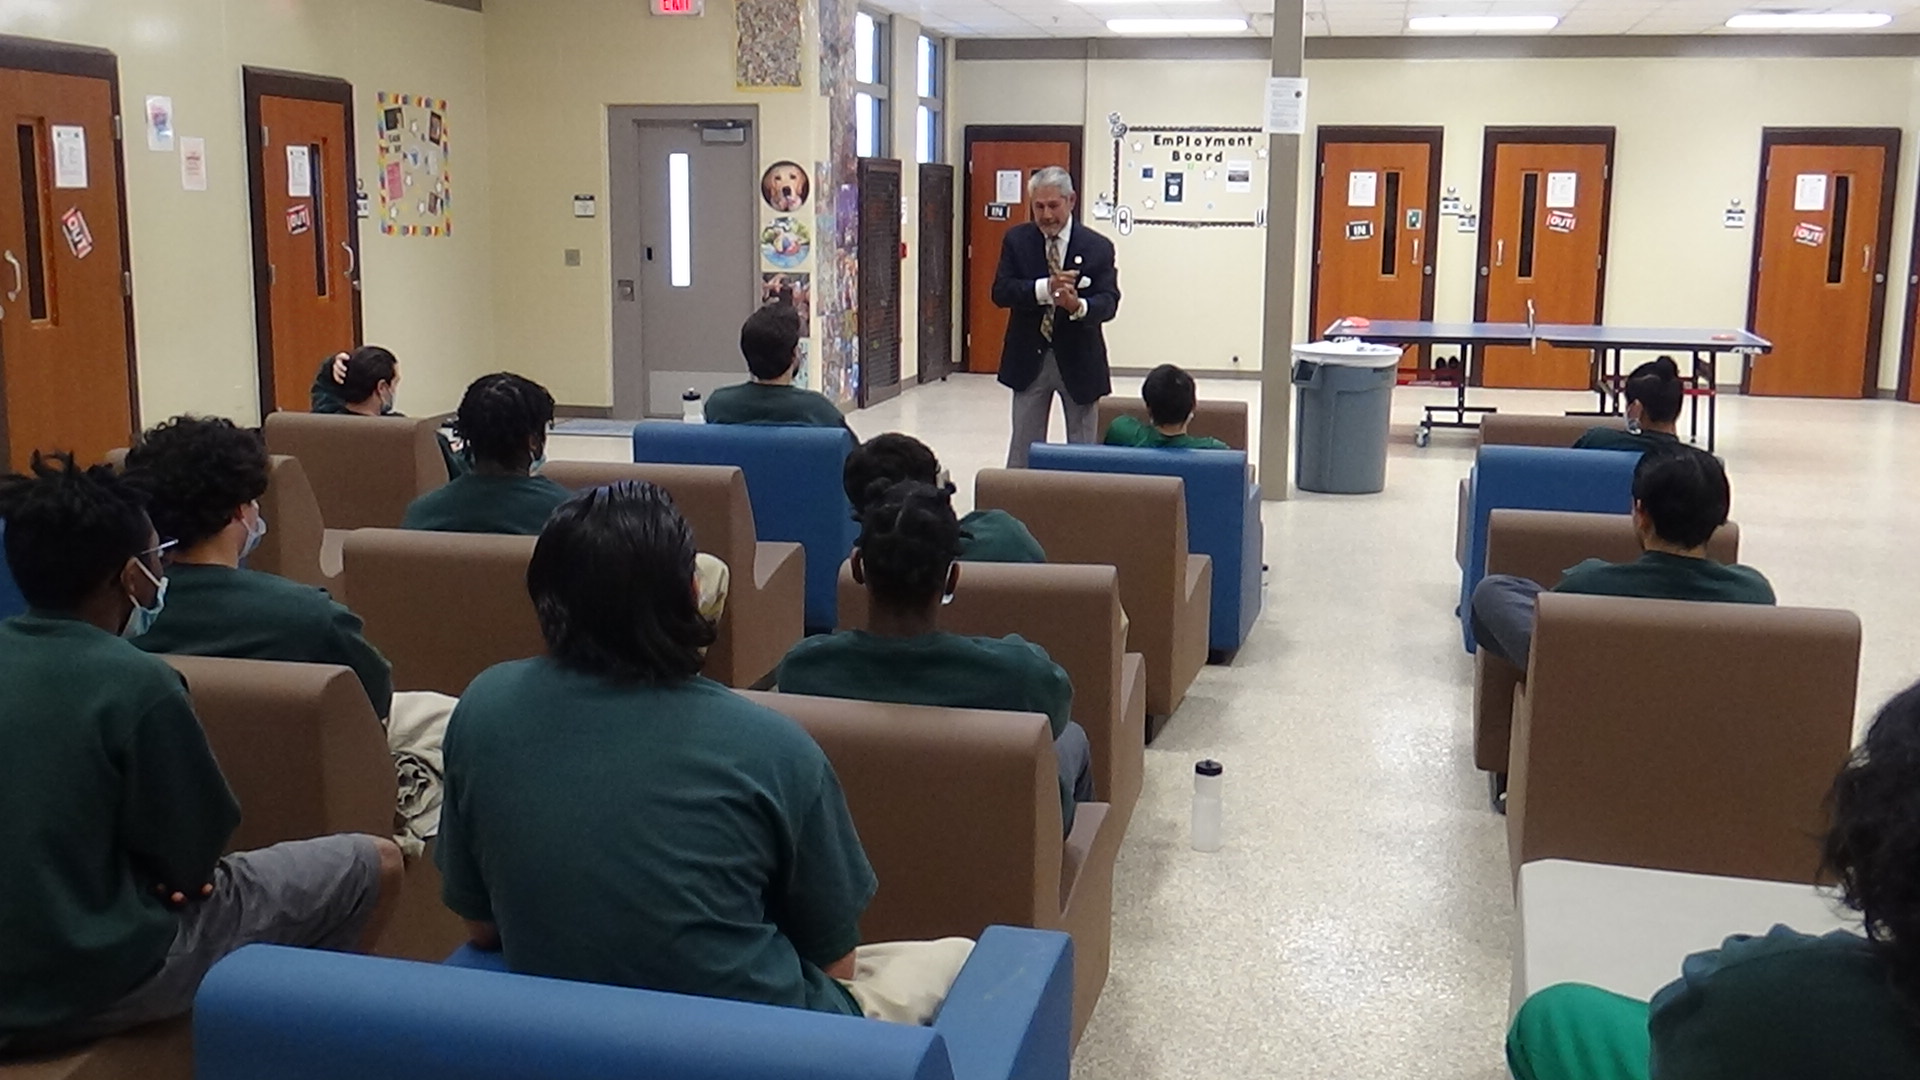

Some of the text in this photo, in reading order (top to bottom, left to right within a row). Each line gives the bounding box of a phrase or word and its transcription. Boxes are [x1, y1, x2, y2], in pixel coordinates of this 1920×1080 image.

[1172, 150, 1223, 163] Board
[991, 206, 1004, 217] IN
[289, 209, 307, 228] OUT
[1550, 215, 1573, 228] OUT
[66, 215, 89, 250] OUT
[1353, 224, 1367, 236] IN
[1797, 228, 1820, 241] OUT
